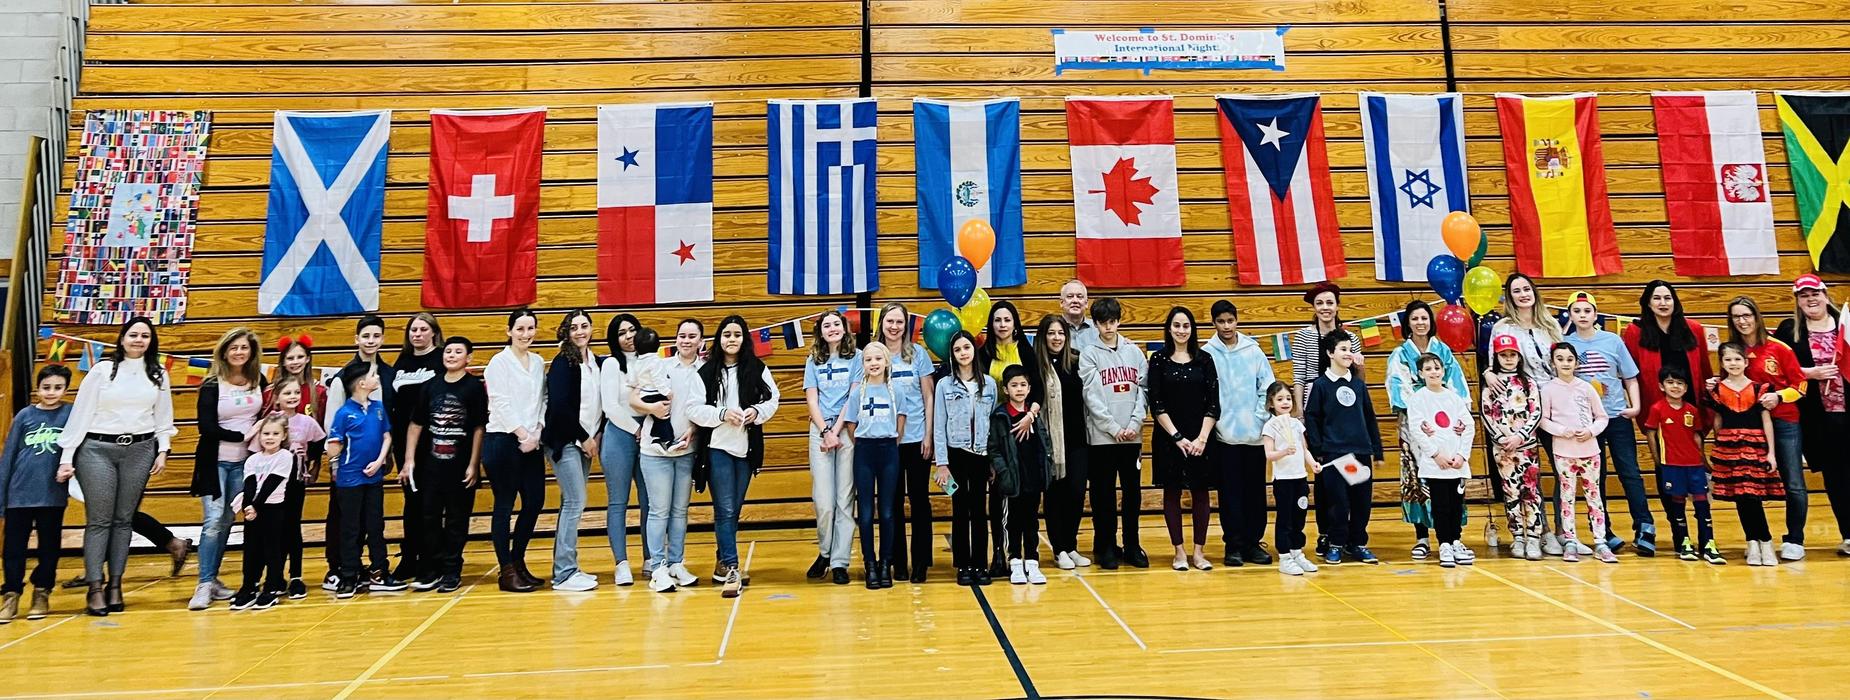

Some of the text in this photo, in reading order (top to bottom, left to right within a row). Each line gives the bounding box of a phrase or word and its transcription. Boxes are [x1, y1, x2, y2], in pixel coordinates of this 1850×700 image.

[1094, 34, 1144, 42] Welcome
[1147, 34, 1159, 42] to
[1162, 34, 1177, 42] St.
[1115, 44, 1185, 52] International
